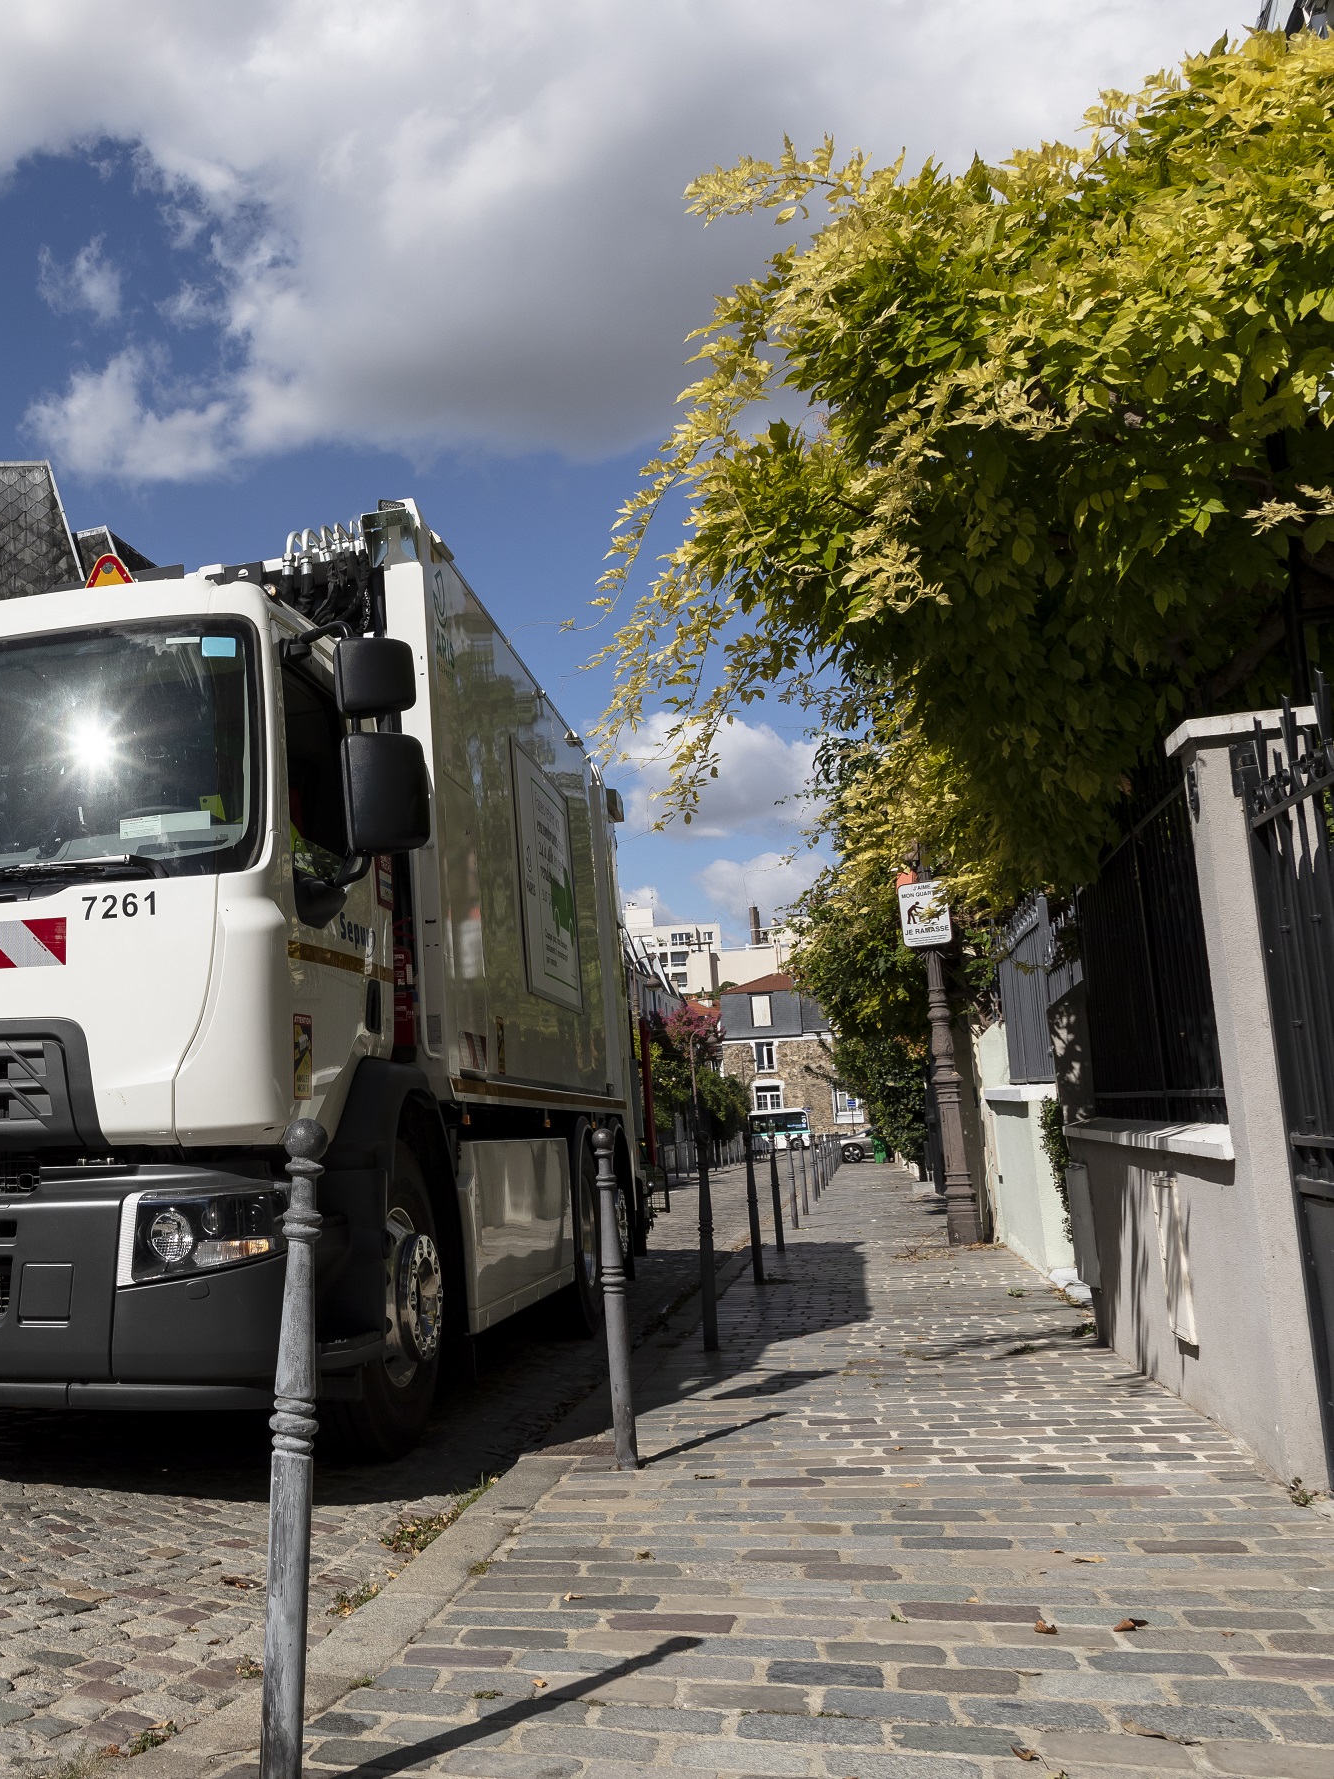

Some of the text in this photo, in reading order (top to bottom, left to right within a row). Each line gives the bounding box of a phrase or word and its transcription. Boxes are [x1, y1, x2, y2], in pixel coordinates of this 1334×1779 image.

[437, 628, 455, 670] ARIS
[81, 891, 156, 920] 7261
[340, 911, 371, 951] Sepur
[294, 1016, 312, 1025] ATTENTION
